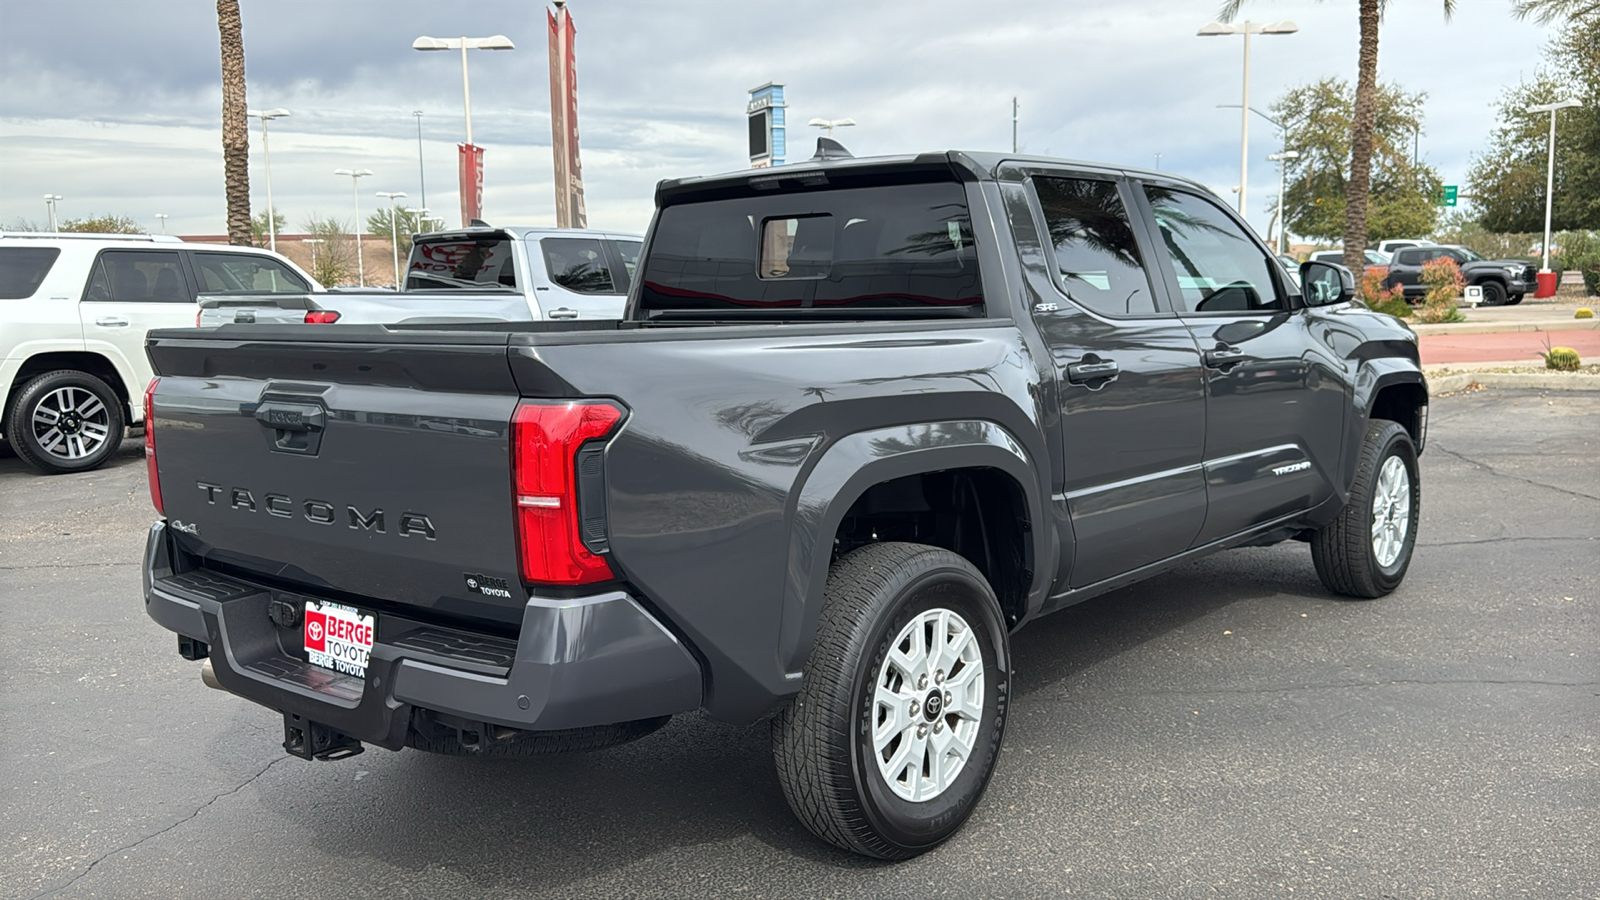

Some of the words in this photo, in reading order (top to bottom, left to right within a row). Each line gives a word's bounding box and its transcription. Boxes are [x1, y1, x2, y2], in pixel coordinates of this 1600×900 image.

[1035, 302, 1059, 312] SR5
[1271, 461, 1312, 477] TACOMA
[196, 480, 437, 541] TACOMA
[477, 573, 509, 589] BERGE
[480, 586, 512, 599] TOYOTA
[327, 615, 372, 646] BERGE
[309, 650, 334, 669] BERGE
[335, 660, 365, 679] TOYOTA
